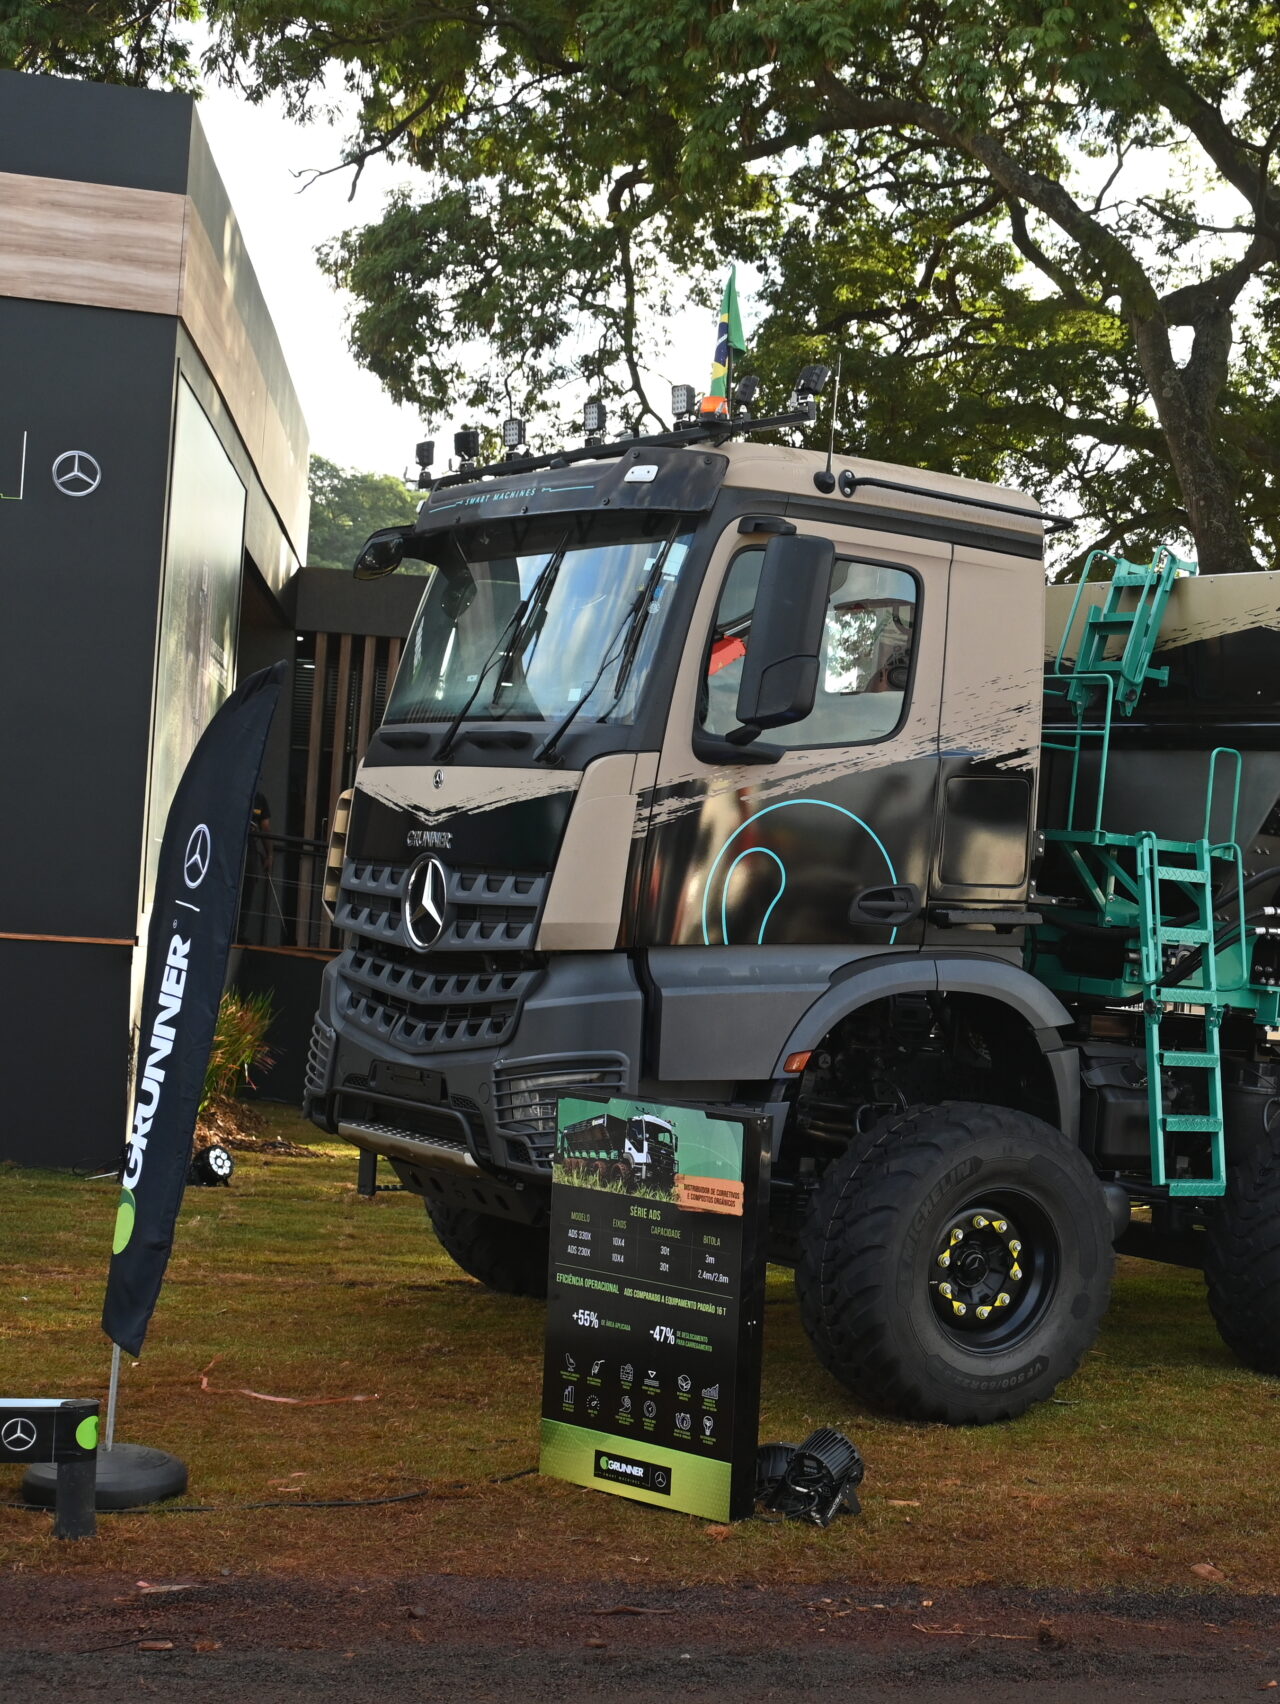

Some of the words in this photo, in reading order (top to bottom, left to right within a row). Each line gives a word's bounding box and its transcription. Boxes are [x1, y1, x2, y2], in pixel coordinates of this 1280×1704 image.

[465, 495, 490, 506] SMART
[494, 488, 537, 501] MACHINES
[123, 932, 191, 1190] GRUNNER
[630, 1206, 647, 1219] SÉRIE
[585, 1278, 620, 1294] OPERACIONAL
[572, 1309, 599, 1328] +55%
[649, 1325, 675, 1344] -47%
[608, 1459, 643, 1477] GRUNNER
